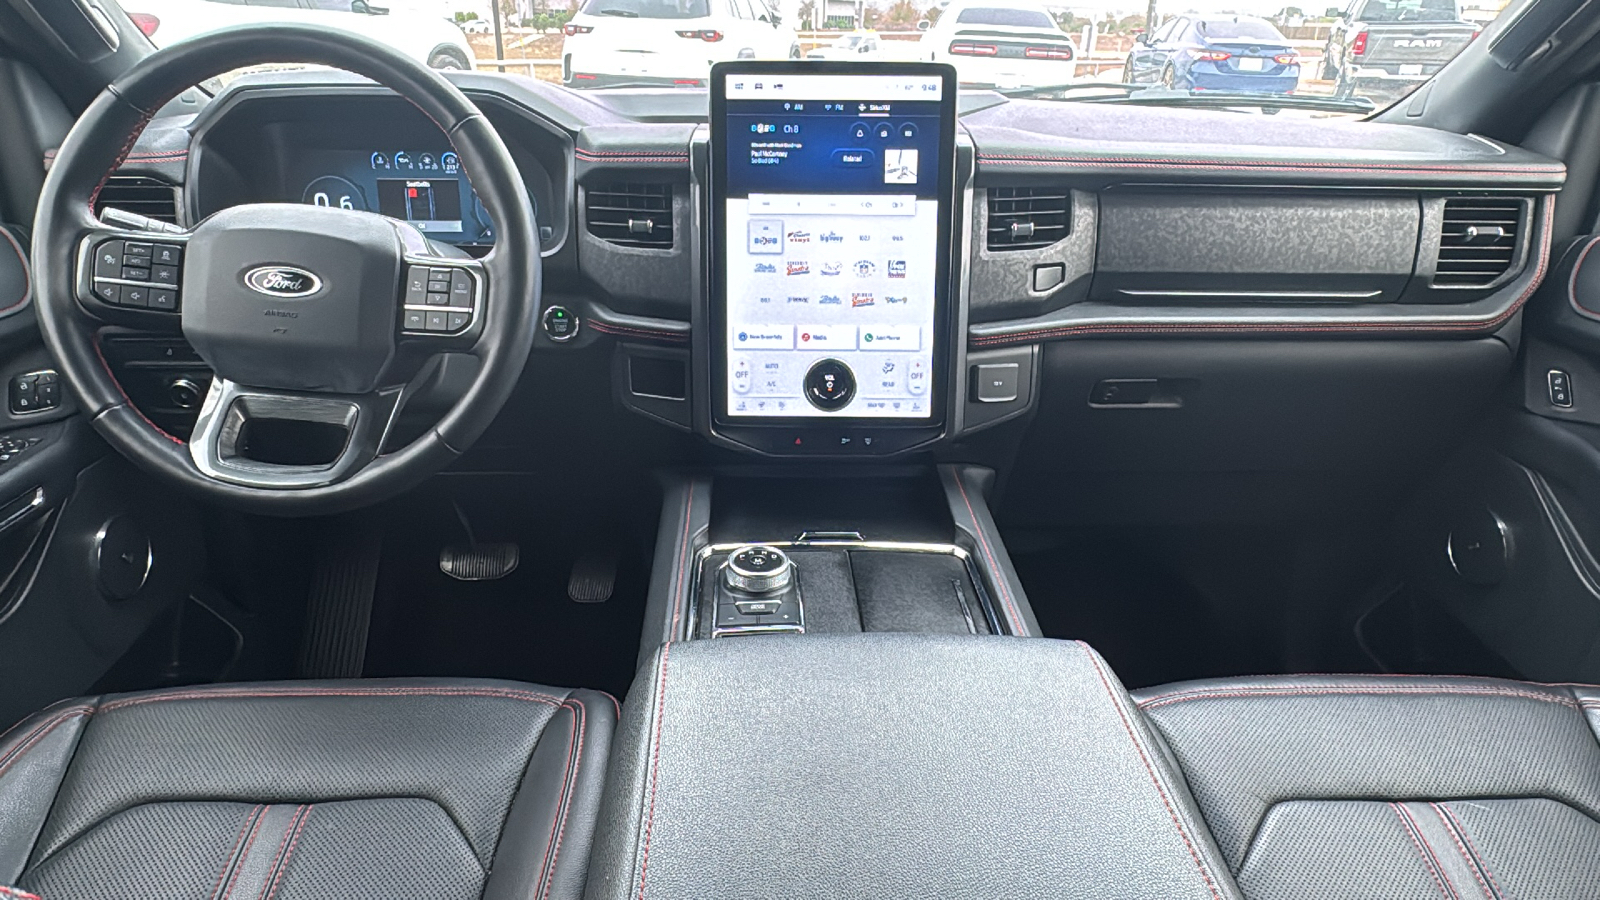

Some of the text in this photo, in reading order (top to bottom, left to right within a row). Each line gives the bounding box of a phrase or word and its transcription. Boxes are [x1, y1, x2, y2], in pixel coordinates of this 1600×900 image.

[1393, 39, 1443, 48] RAM
[794, 103, 804, 111] AM
[835, 103, 844, 111] FM
[869, 103, 891, 111] SiriusXM
[783, 124, 793, 134] Ch
[793, 124, 800, 134] 8
[263, 272, 303, 290] Ford
[735, 371, 749, 379] OFF
[910, 372, 924, 380] OFF
